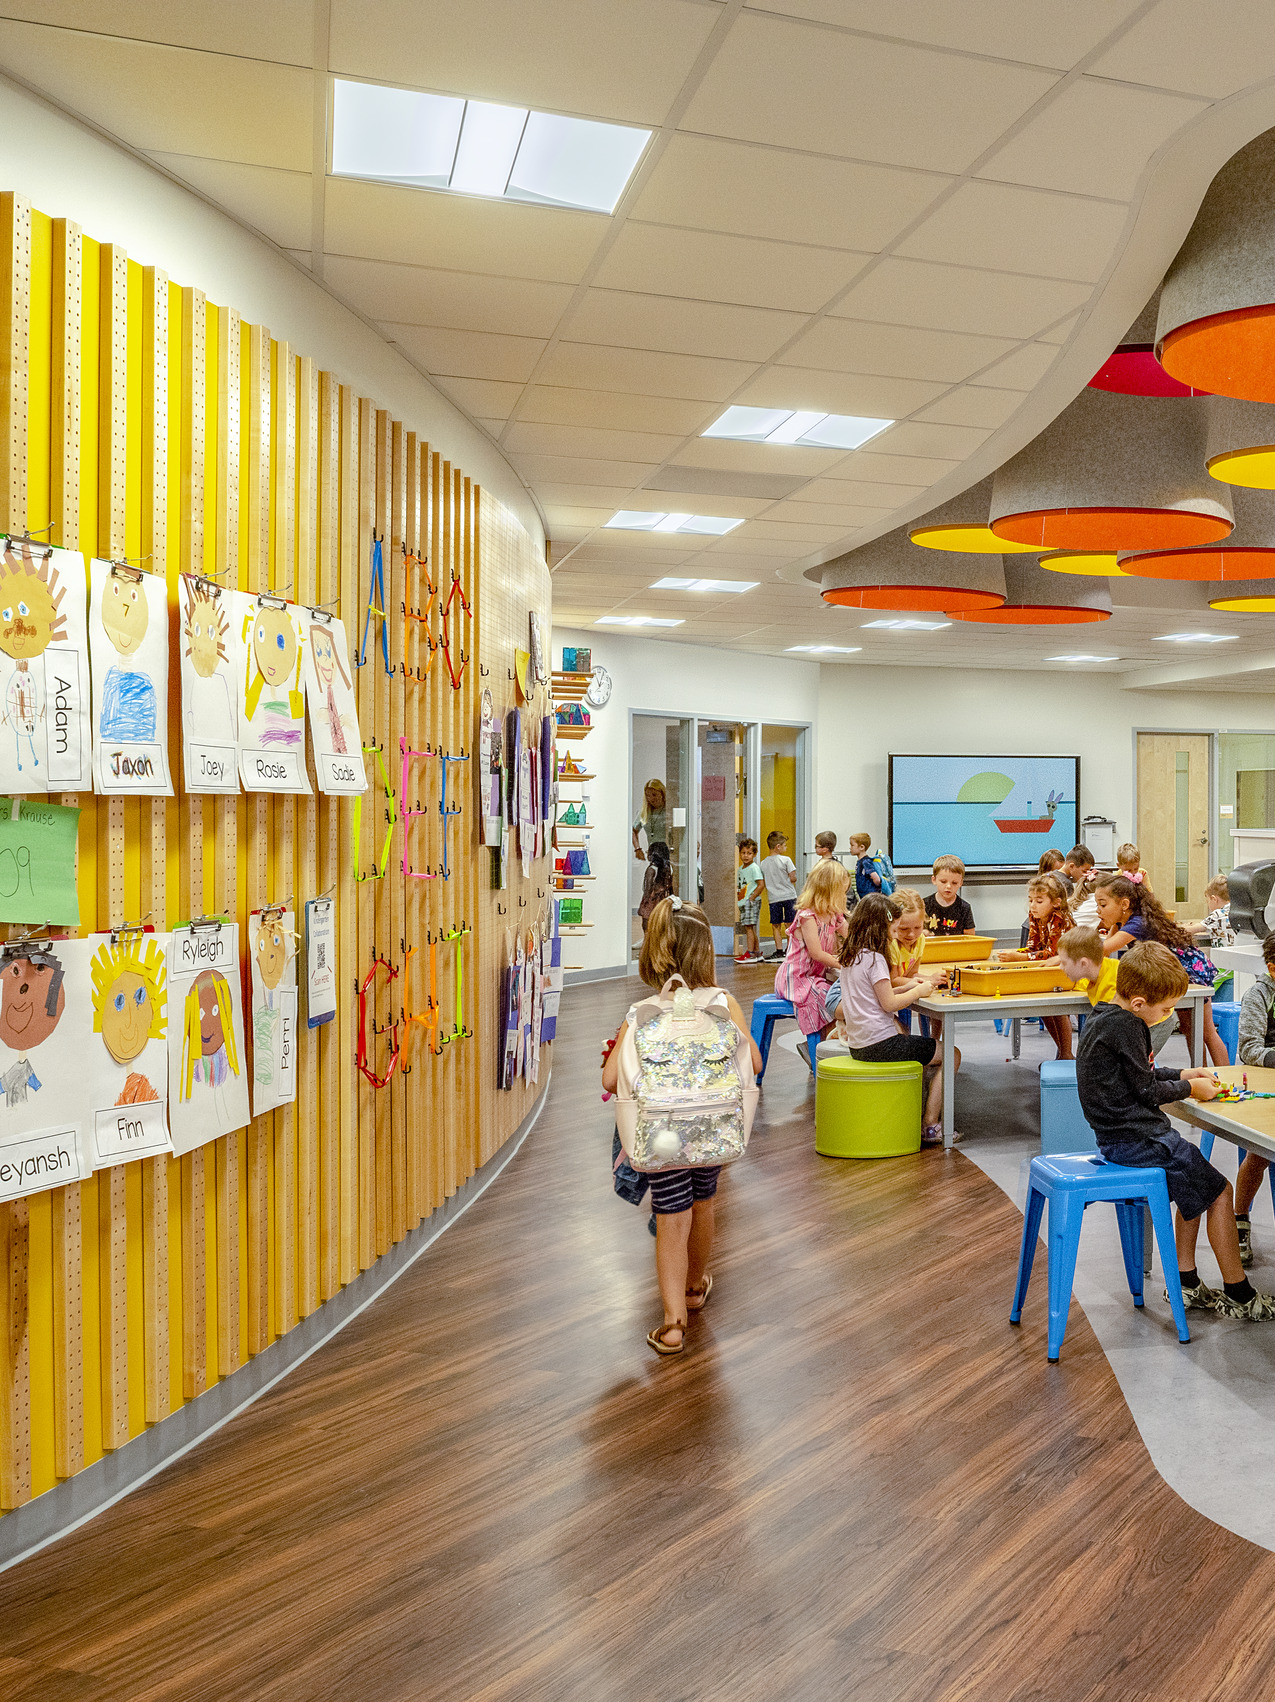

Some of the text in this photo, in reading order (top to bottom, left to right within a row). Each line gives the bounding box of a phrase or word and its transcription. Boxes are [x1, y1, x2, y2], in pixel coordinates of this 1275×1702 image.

[54, 676, 73, 754] Adam
[110, 751, 154, 779] Jaxon
[200, 754, 225, 782] Joey
[256, 759, 288, 779] Rosie
[331, 763, 356, 781] Sadie
[20, 806, 56, 826] Krause
[182, 936, 224, 965] Ryleigh
[281, 1017, 290, 1070] Perri
[117, 1117, 145, 1141] Finn
[0, 1145, 71, 1186] eyansh
